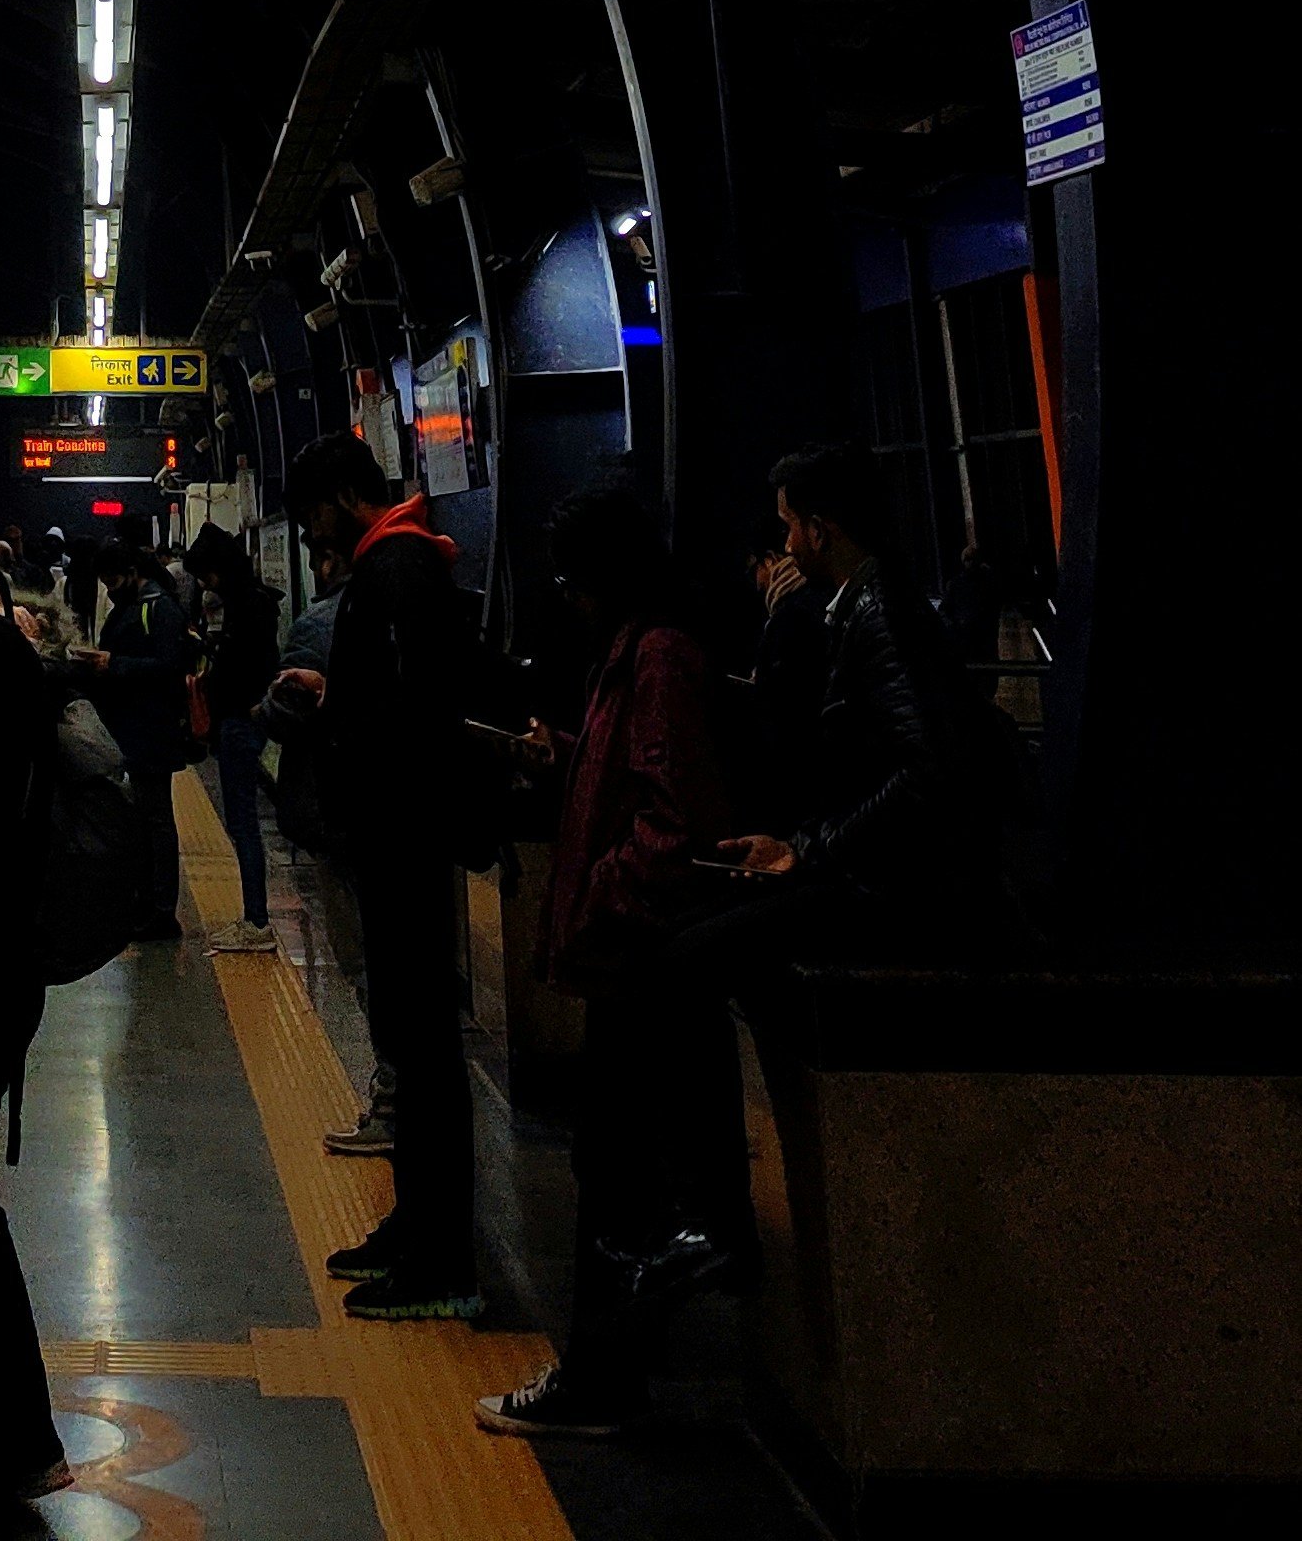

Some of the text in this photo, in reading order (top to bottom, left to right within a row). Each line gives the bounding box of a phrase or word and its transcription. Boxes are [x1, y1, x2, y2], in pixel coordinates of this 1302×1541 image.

[90, 355, 132, 372] निकास
[107, 373, 133, 385] Exit
[24, 438, 176, 452] Train Coaches 8
